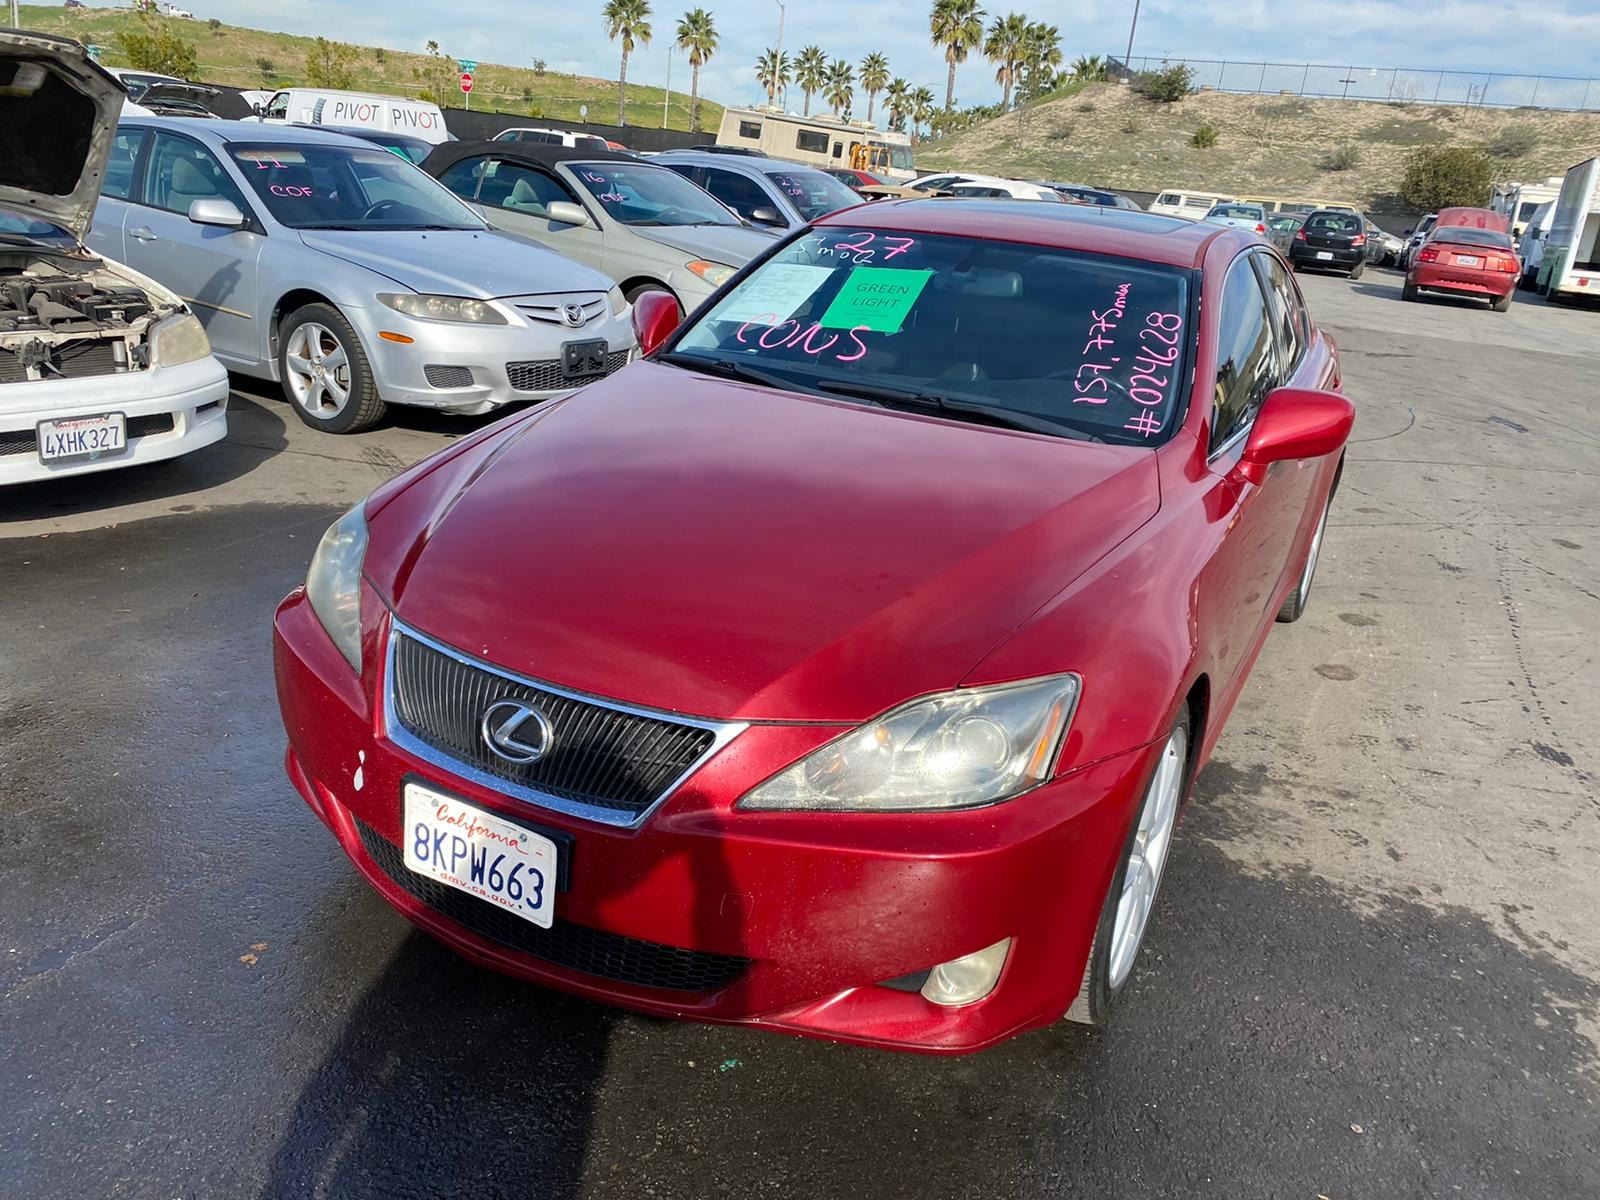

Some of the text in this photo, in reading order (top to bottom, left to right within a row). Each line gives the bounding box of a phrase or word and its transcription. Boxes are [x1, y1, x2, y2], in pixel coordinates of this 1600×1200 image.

[334, 102, 379, 122] PIVOT
[392, 108, 438, 129] PIVOT
[580, 170, 605, 183] 16
[834, 231, 915, 261] 27
[856, 282, 912, 295] GREEN
[852, 297, 900, 308] LIGHT
[45, 425, 119, 456] 4XHK327
[436, 803, 529, 856] California
[413, 822, 545, 910] 8KPW663
